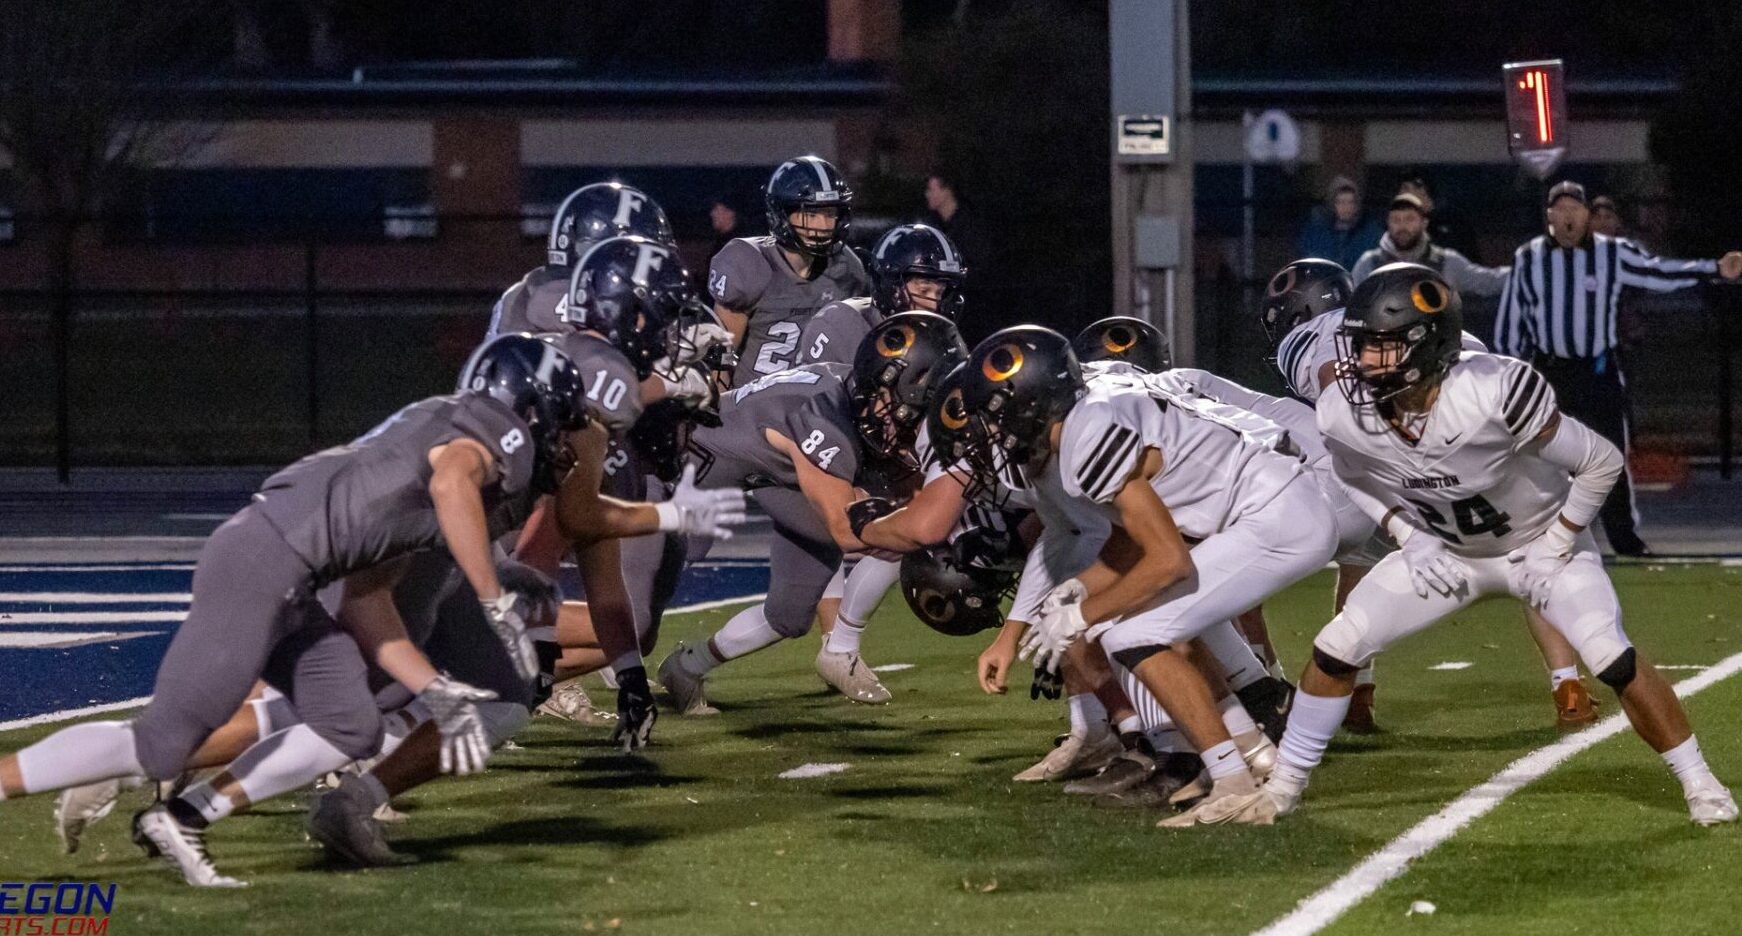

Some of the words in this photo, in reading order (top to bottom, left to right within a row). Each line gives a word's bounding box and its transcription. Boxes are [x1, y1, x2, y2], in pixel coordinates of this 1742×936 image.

[612, 188, 648, 227] F
[630, 243, 669, 287] F
[709, 269, 727, 297] 24
[535, 341, 569, 386] F
[754, 321, 804, 375] 2
[810, 333, 830, 359] 5
[586, 370, 627, 411] 10
[500, 428, 524, 454] 8
[801, 429, 841, 470] 84
[1401, 475, 1461, 489] LUDINGTON
[1403, 494, 1513, 545] 24
